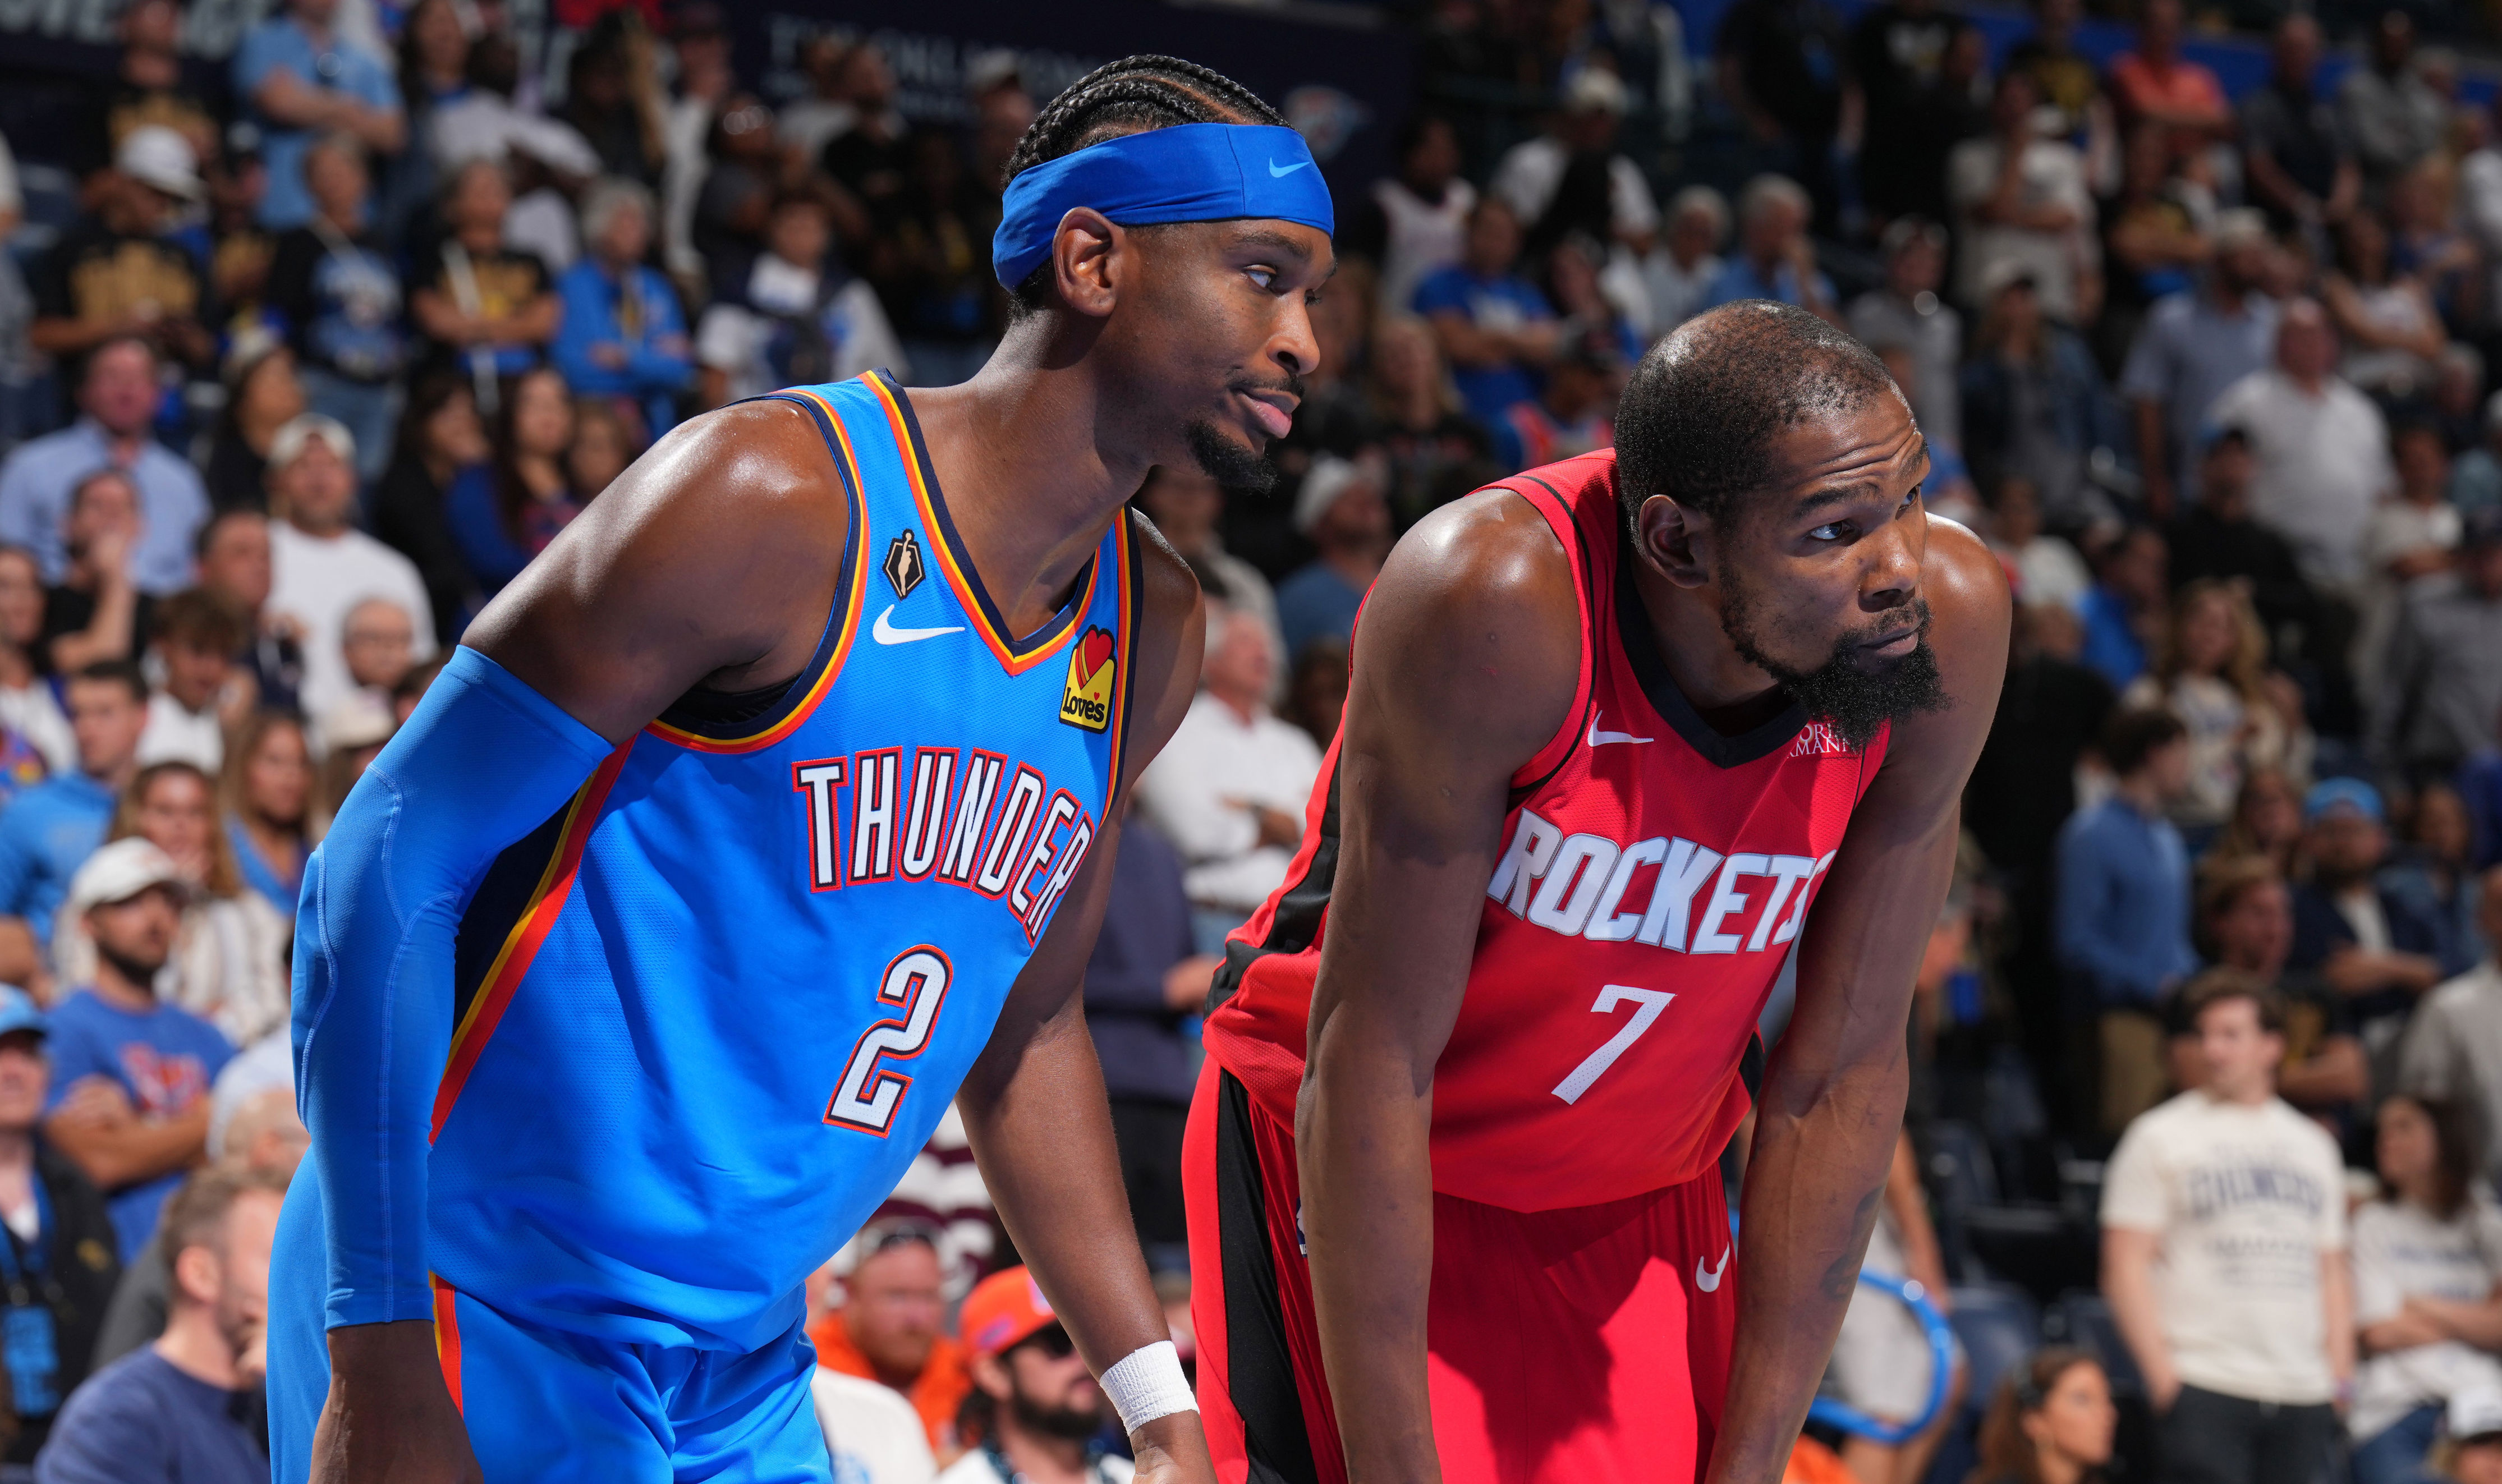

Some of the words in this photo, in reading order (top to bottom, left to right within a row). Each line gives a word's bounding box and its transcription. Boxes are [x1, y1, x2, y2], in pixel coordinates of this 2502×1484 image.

[791, 746, 1095, 948] THUNDER
[1486, 807, 1837, 954] ROCKETS
[823, 944, 953, 1138] 2
[1551, 985, 1676, 1105] 7
